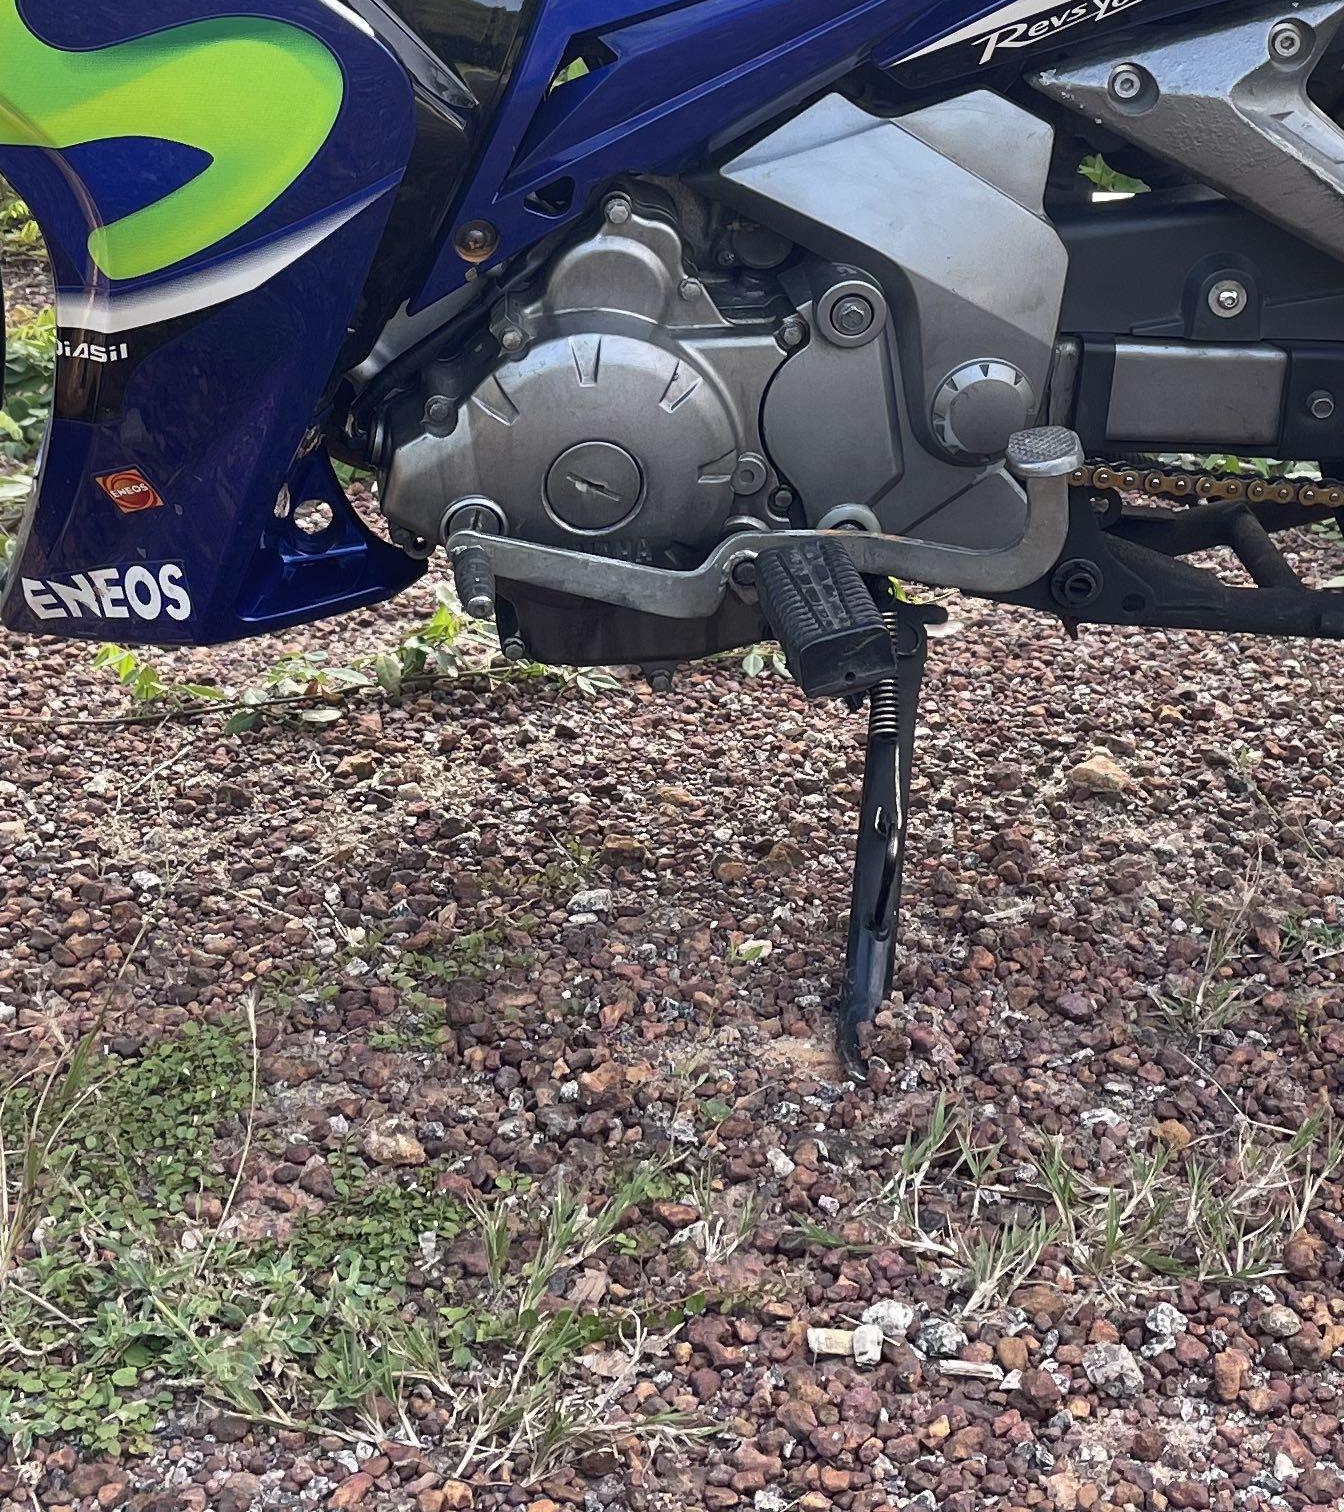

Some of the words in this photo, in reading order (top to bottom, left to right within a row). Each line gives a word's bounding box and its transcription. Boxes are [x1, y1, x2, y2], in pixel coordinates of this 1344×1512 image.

[971, 0, 1088, 65] Revs
[110, 483, 149, 498] ENEOS
[21, 563, 191, 622] ENEOS
